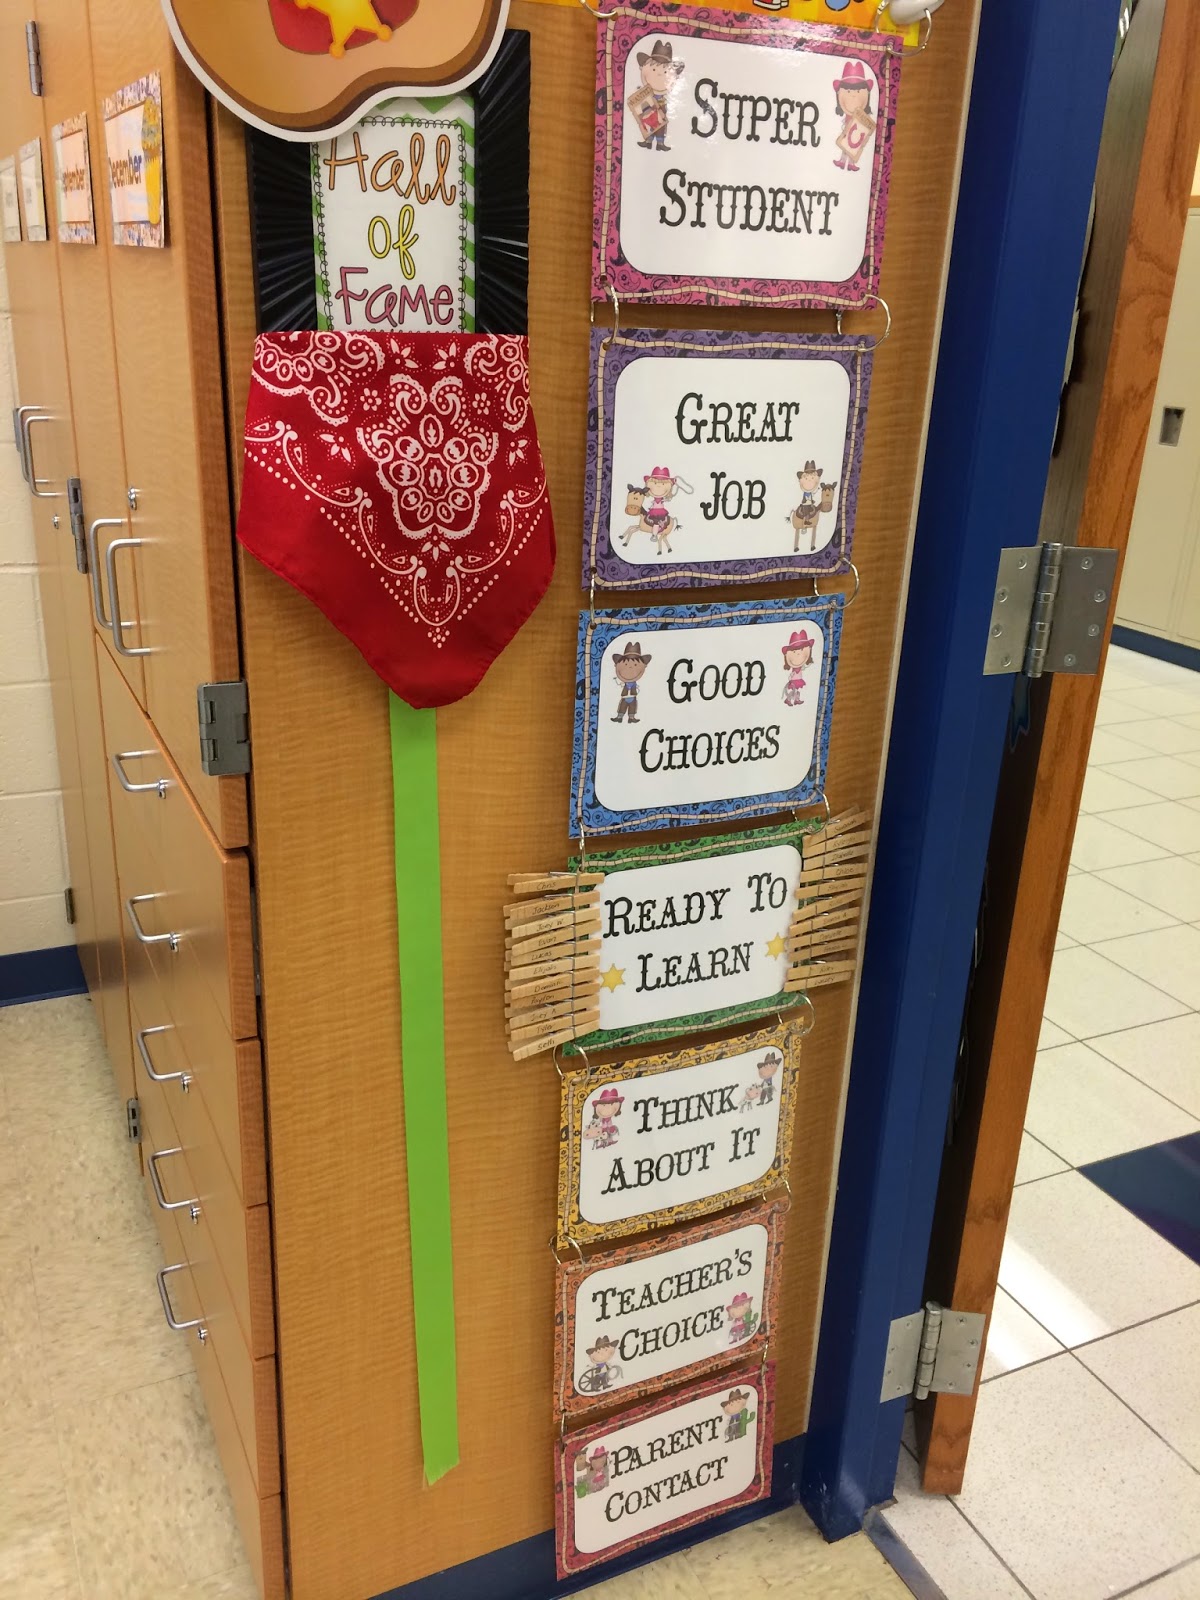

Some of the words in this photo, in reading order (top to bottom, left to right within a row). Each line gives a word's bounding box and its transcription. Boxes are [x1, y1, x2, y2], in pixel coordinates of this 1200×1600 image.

[690, 78, 821, 148] SUPER
[324, 131, 456, 206] Hall
[659, 168, 839, 236] STUDENT
[675, 392, 800, 445] GREAT
[700, 471, 766, 520] JOB
[667, 658, 766, 704] GOOD
[639, 725, 781, 772] CHOICES
[532, 903, 560, 915] Jackson
[536, 881, 556, 890] Chris
[602, 887, 731, 939] READY
[747, 872, 788, 914] TO
[533, 965, 557, 976] Elijah
[635, 941, 755, 993] LEARN
[633, 1083, 740, 1134] THINK
[601, 1141, 715, 1194] ABOUT
[728, 1126, 760, 1163] IT
[618, 1305, 725, 1362] CHOICE
[610, 1415, 723, 1479] PARENT
[604, 1455, 728, 1523] CONTACT
